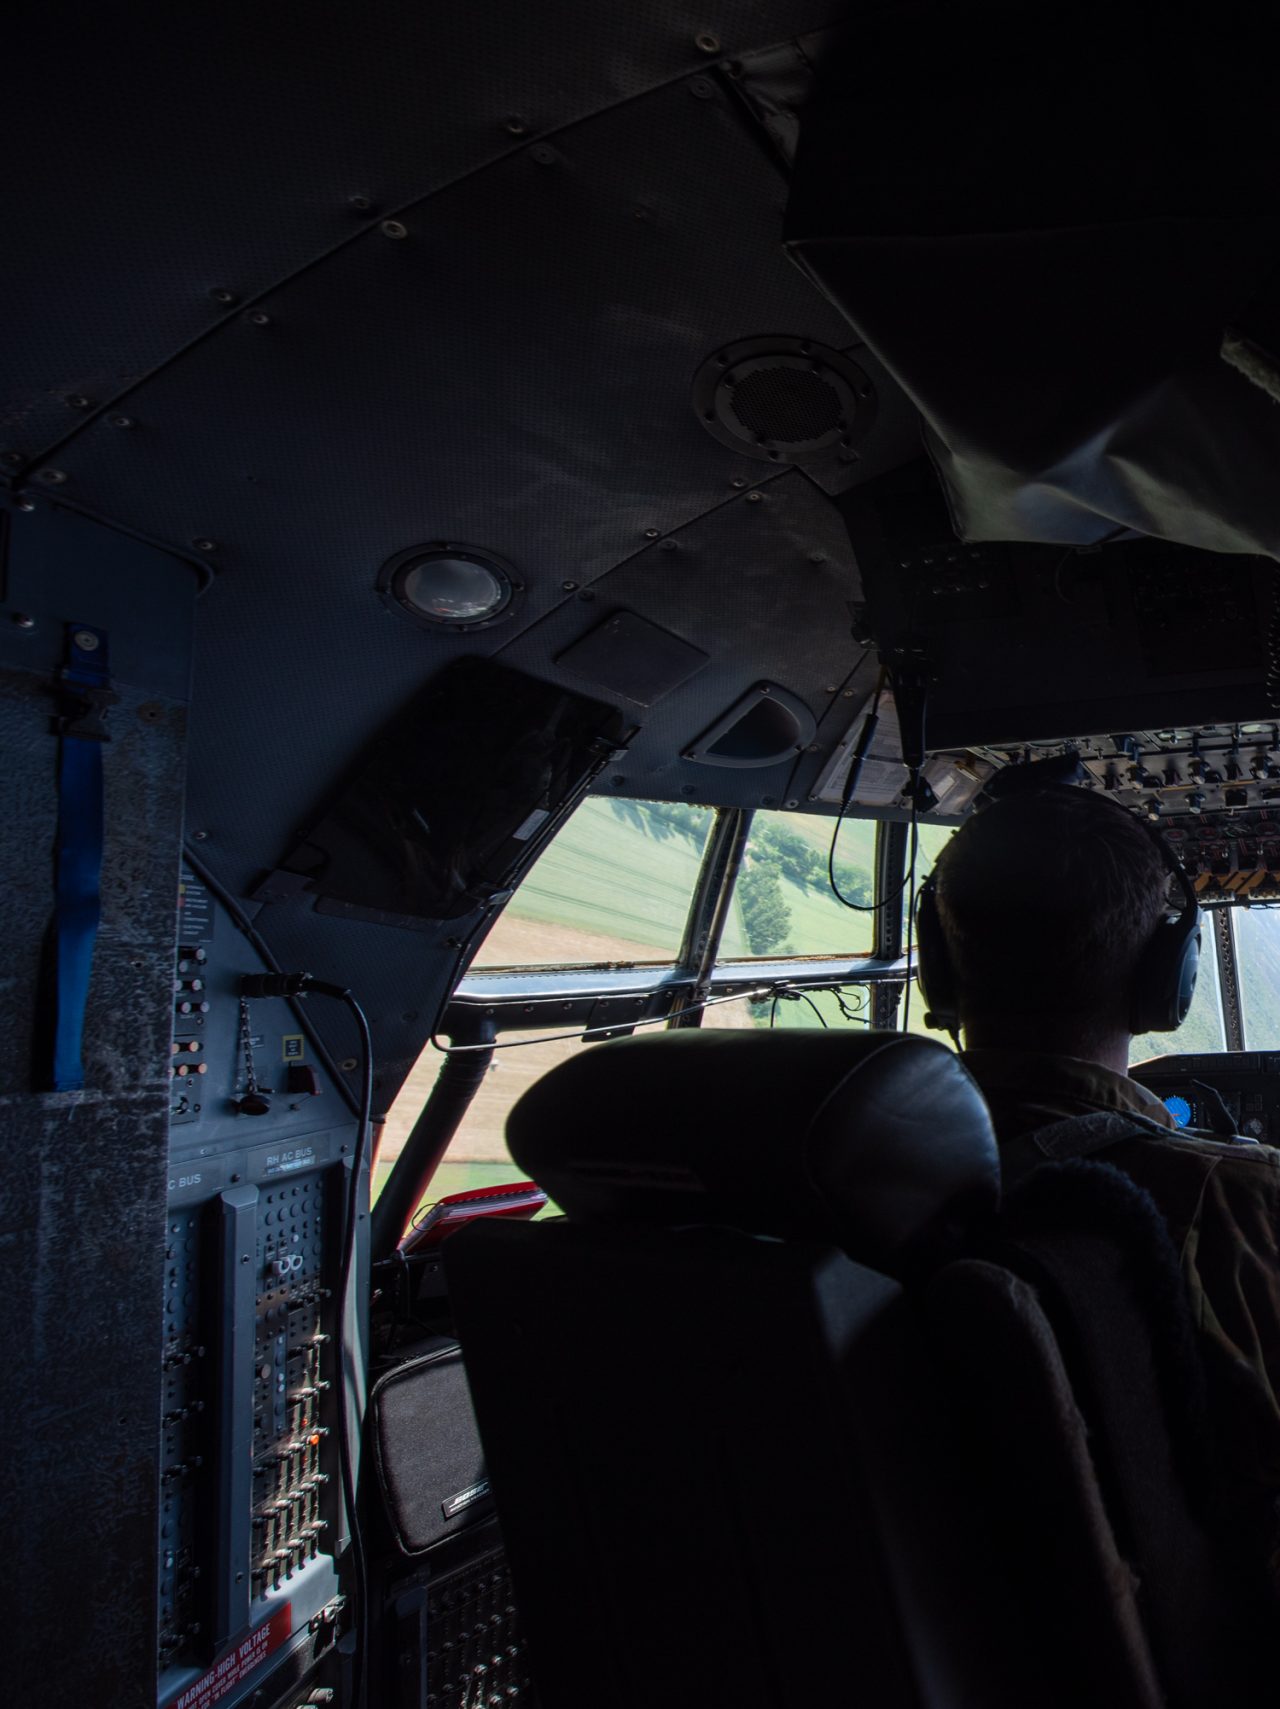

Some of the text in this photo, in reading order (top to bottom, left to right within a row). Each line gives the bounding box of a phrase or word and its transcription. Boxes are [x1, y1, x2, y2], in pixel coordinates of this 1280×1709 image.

[266, 1155, 280, 1167] RH
[281, 1150, 295, 1162] AC
[295, 1146, 313, 1160] BUS
[178, 1173, 202, 1188] BUS
[239, 1622, 271, 1658] VOLTAGE
